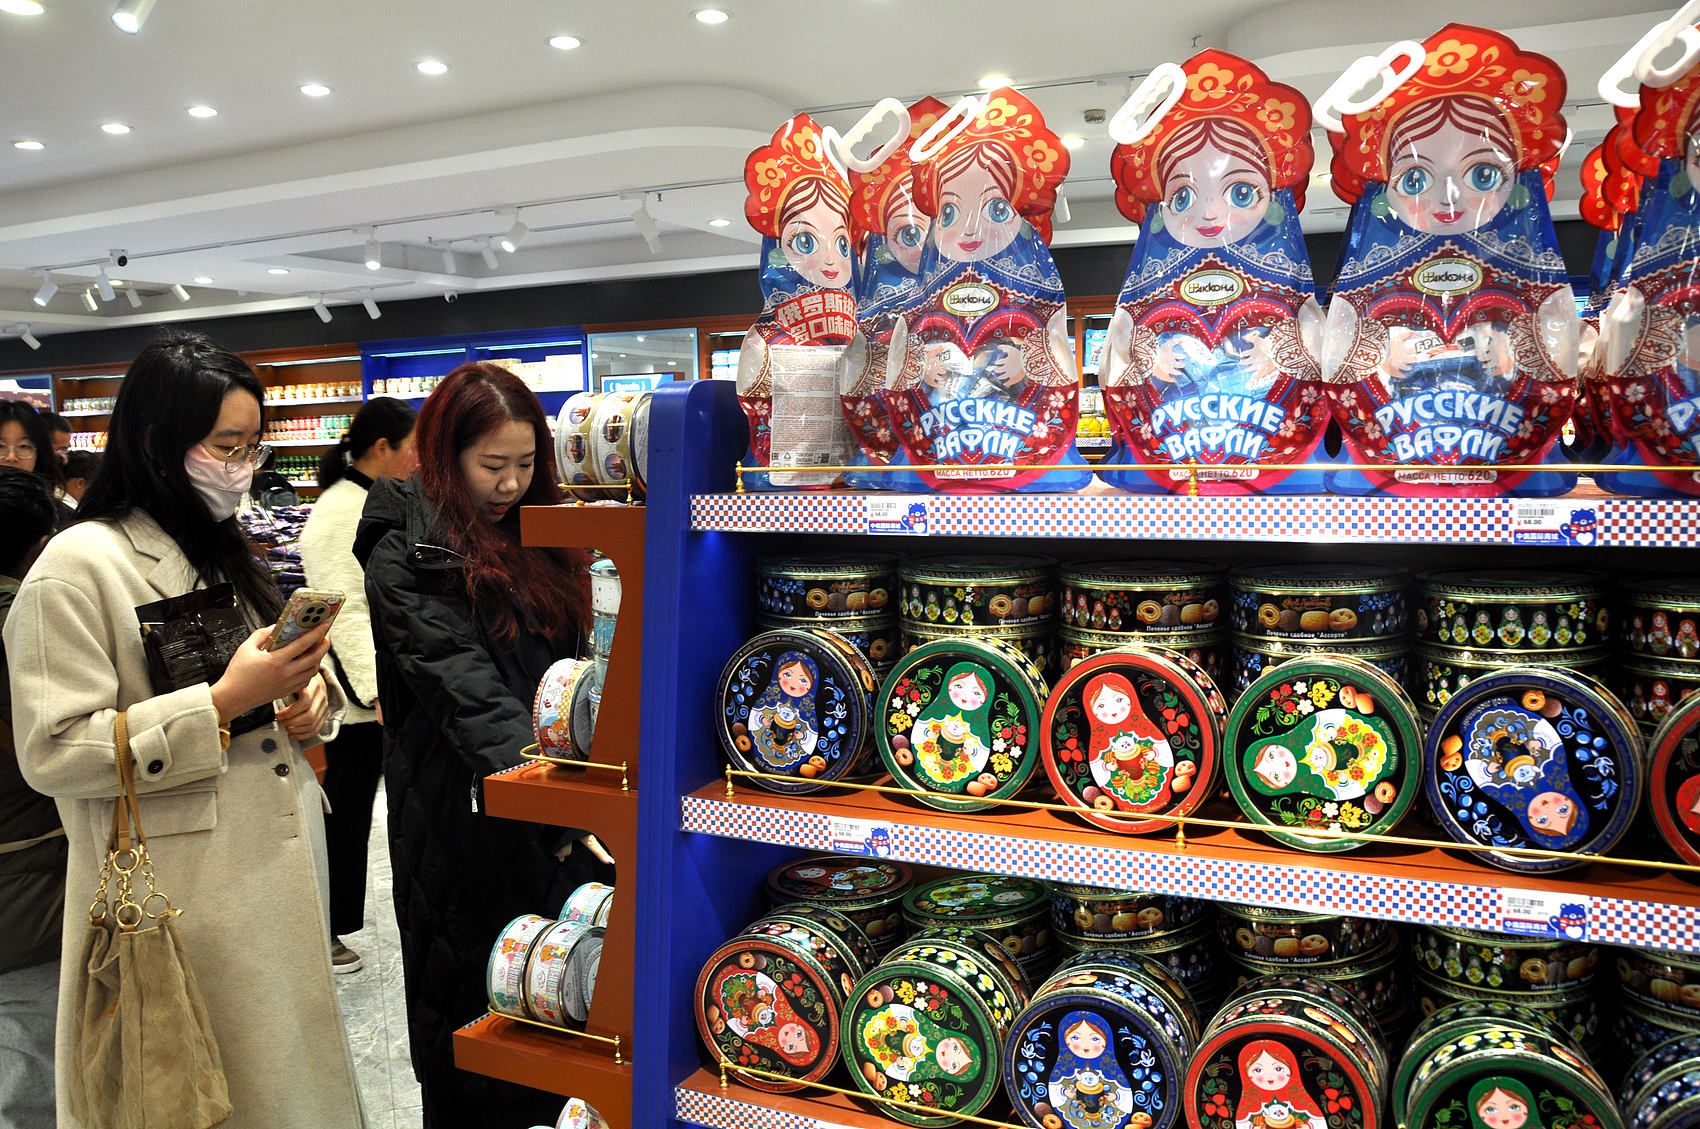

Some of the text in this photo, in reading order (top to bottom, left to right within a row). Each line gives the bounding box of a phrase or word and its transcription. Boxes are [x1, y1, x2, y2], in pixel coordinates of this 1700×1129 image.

[920, 398, 1036, 437] РУССКИЕ
[1151, 394, 1285, 436] РУССКИЕ
[1374, 391, 1524, 434] РУССКИЕ
[933, 428, 1020, 460] ВАФЛИ
[1164, 425, 1265, 461] ВАФЛИ
[1393, 426, 1504, 462] ВАФЛИ
[1398, 472, 1431, 480] МАССА
